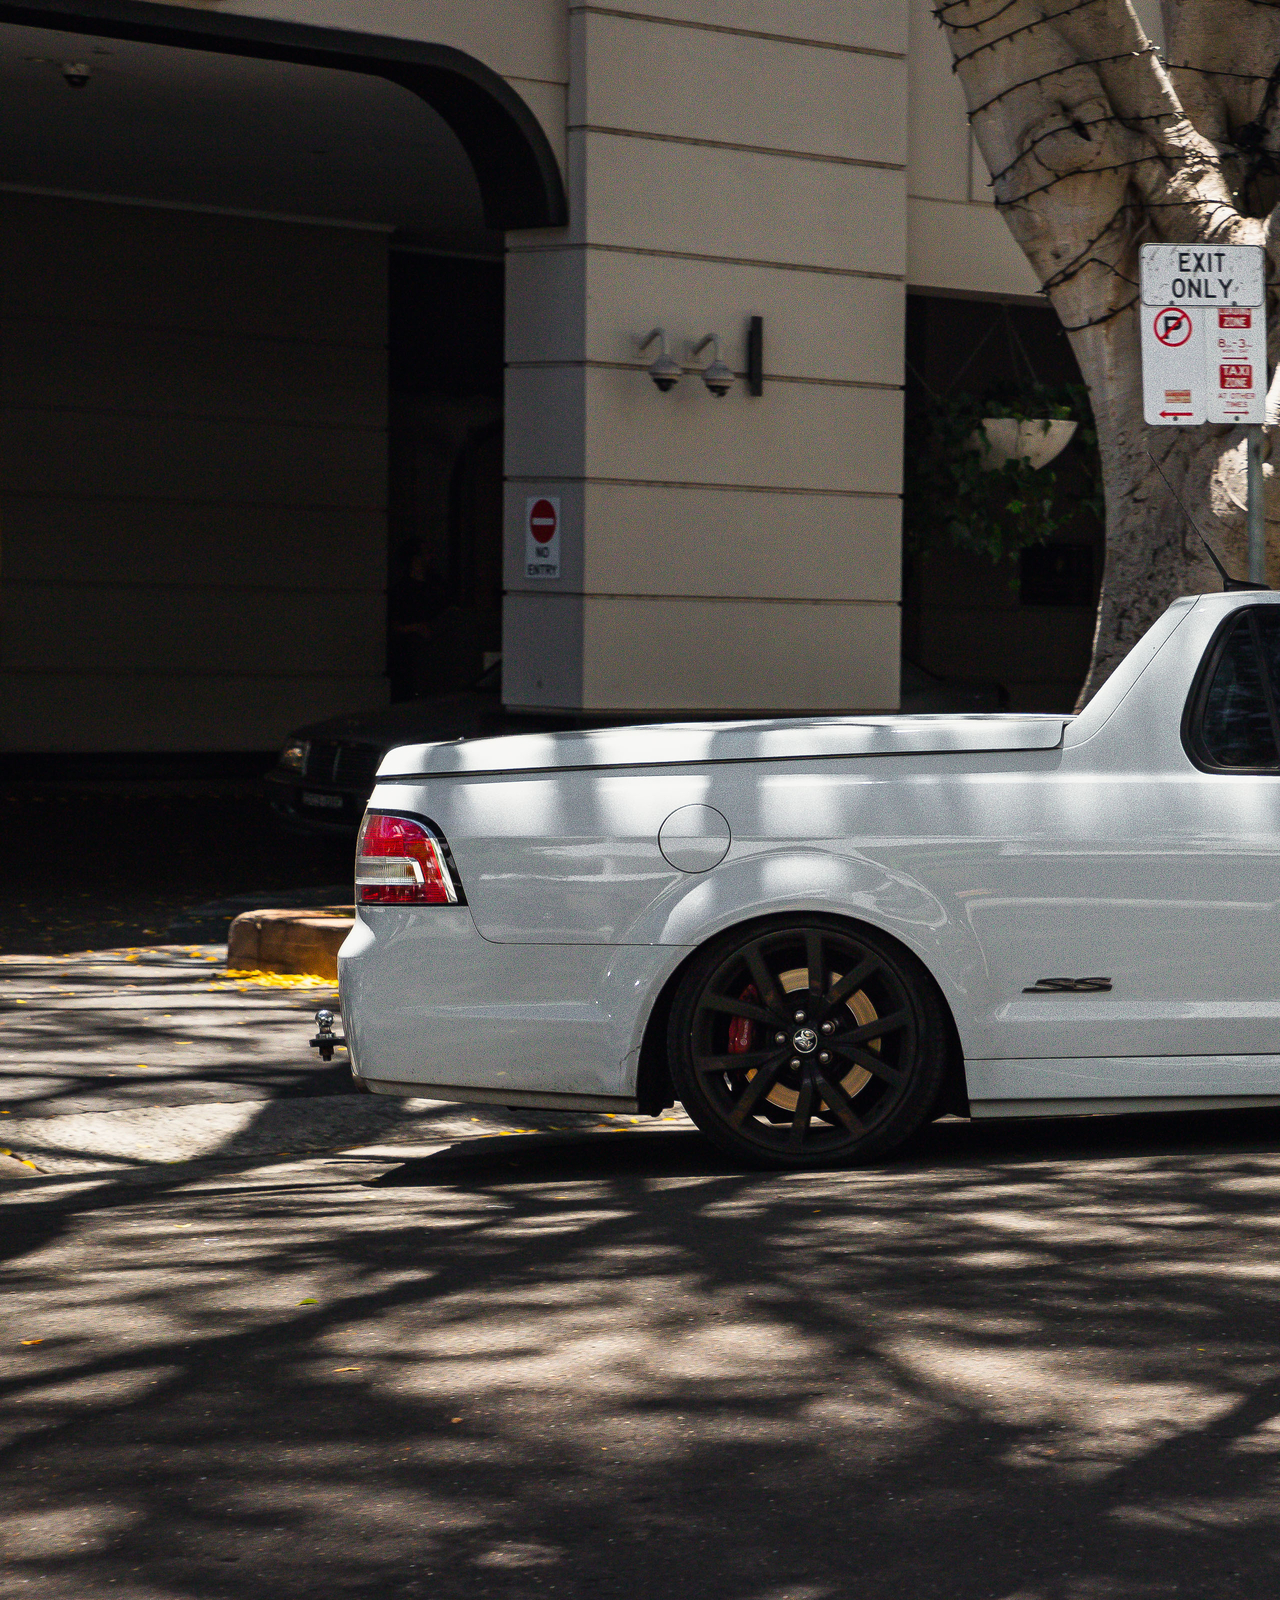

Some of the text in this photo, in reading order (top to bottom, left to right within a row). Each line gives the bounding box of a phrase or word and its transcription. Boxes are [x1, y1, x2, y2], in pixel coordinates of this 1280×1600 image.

[1178, 252, 1226, 273] EXIT
[1171, 278, 1234, 299] ONLY
[1223, 317, 1248, 327] ZONE
[1221, 365, 1250, 376] TAXI
[1223, 377, 1248, 387] ZONE
[535, 546, 550, 558] NO
[527, 563, 557, 576] ENTRY
